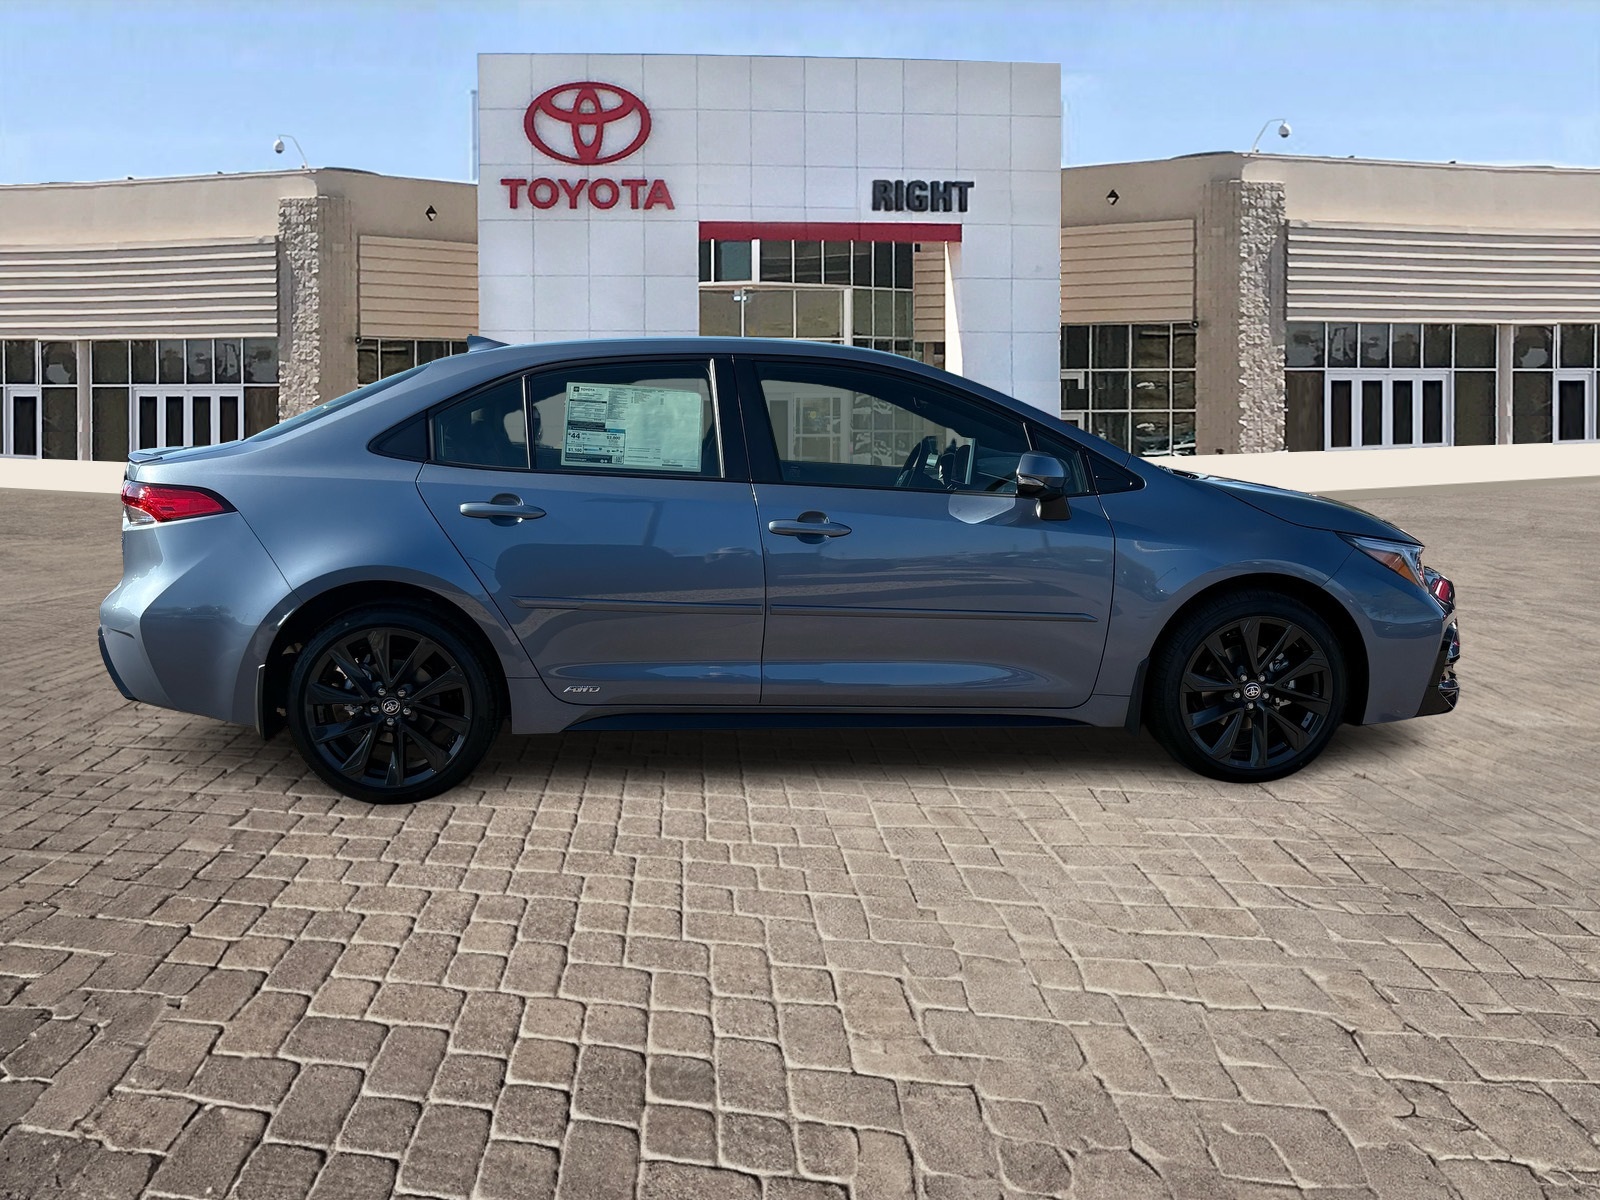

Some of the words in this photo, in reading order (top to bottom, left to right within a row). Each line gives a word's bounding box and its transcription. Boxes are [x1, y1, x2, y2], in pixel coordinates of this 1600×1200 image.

[500, 177, 675, 210] TOYOTA
[872, 179, 975, 212] RIGHT
[570, 432, 580, 440] 44
